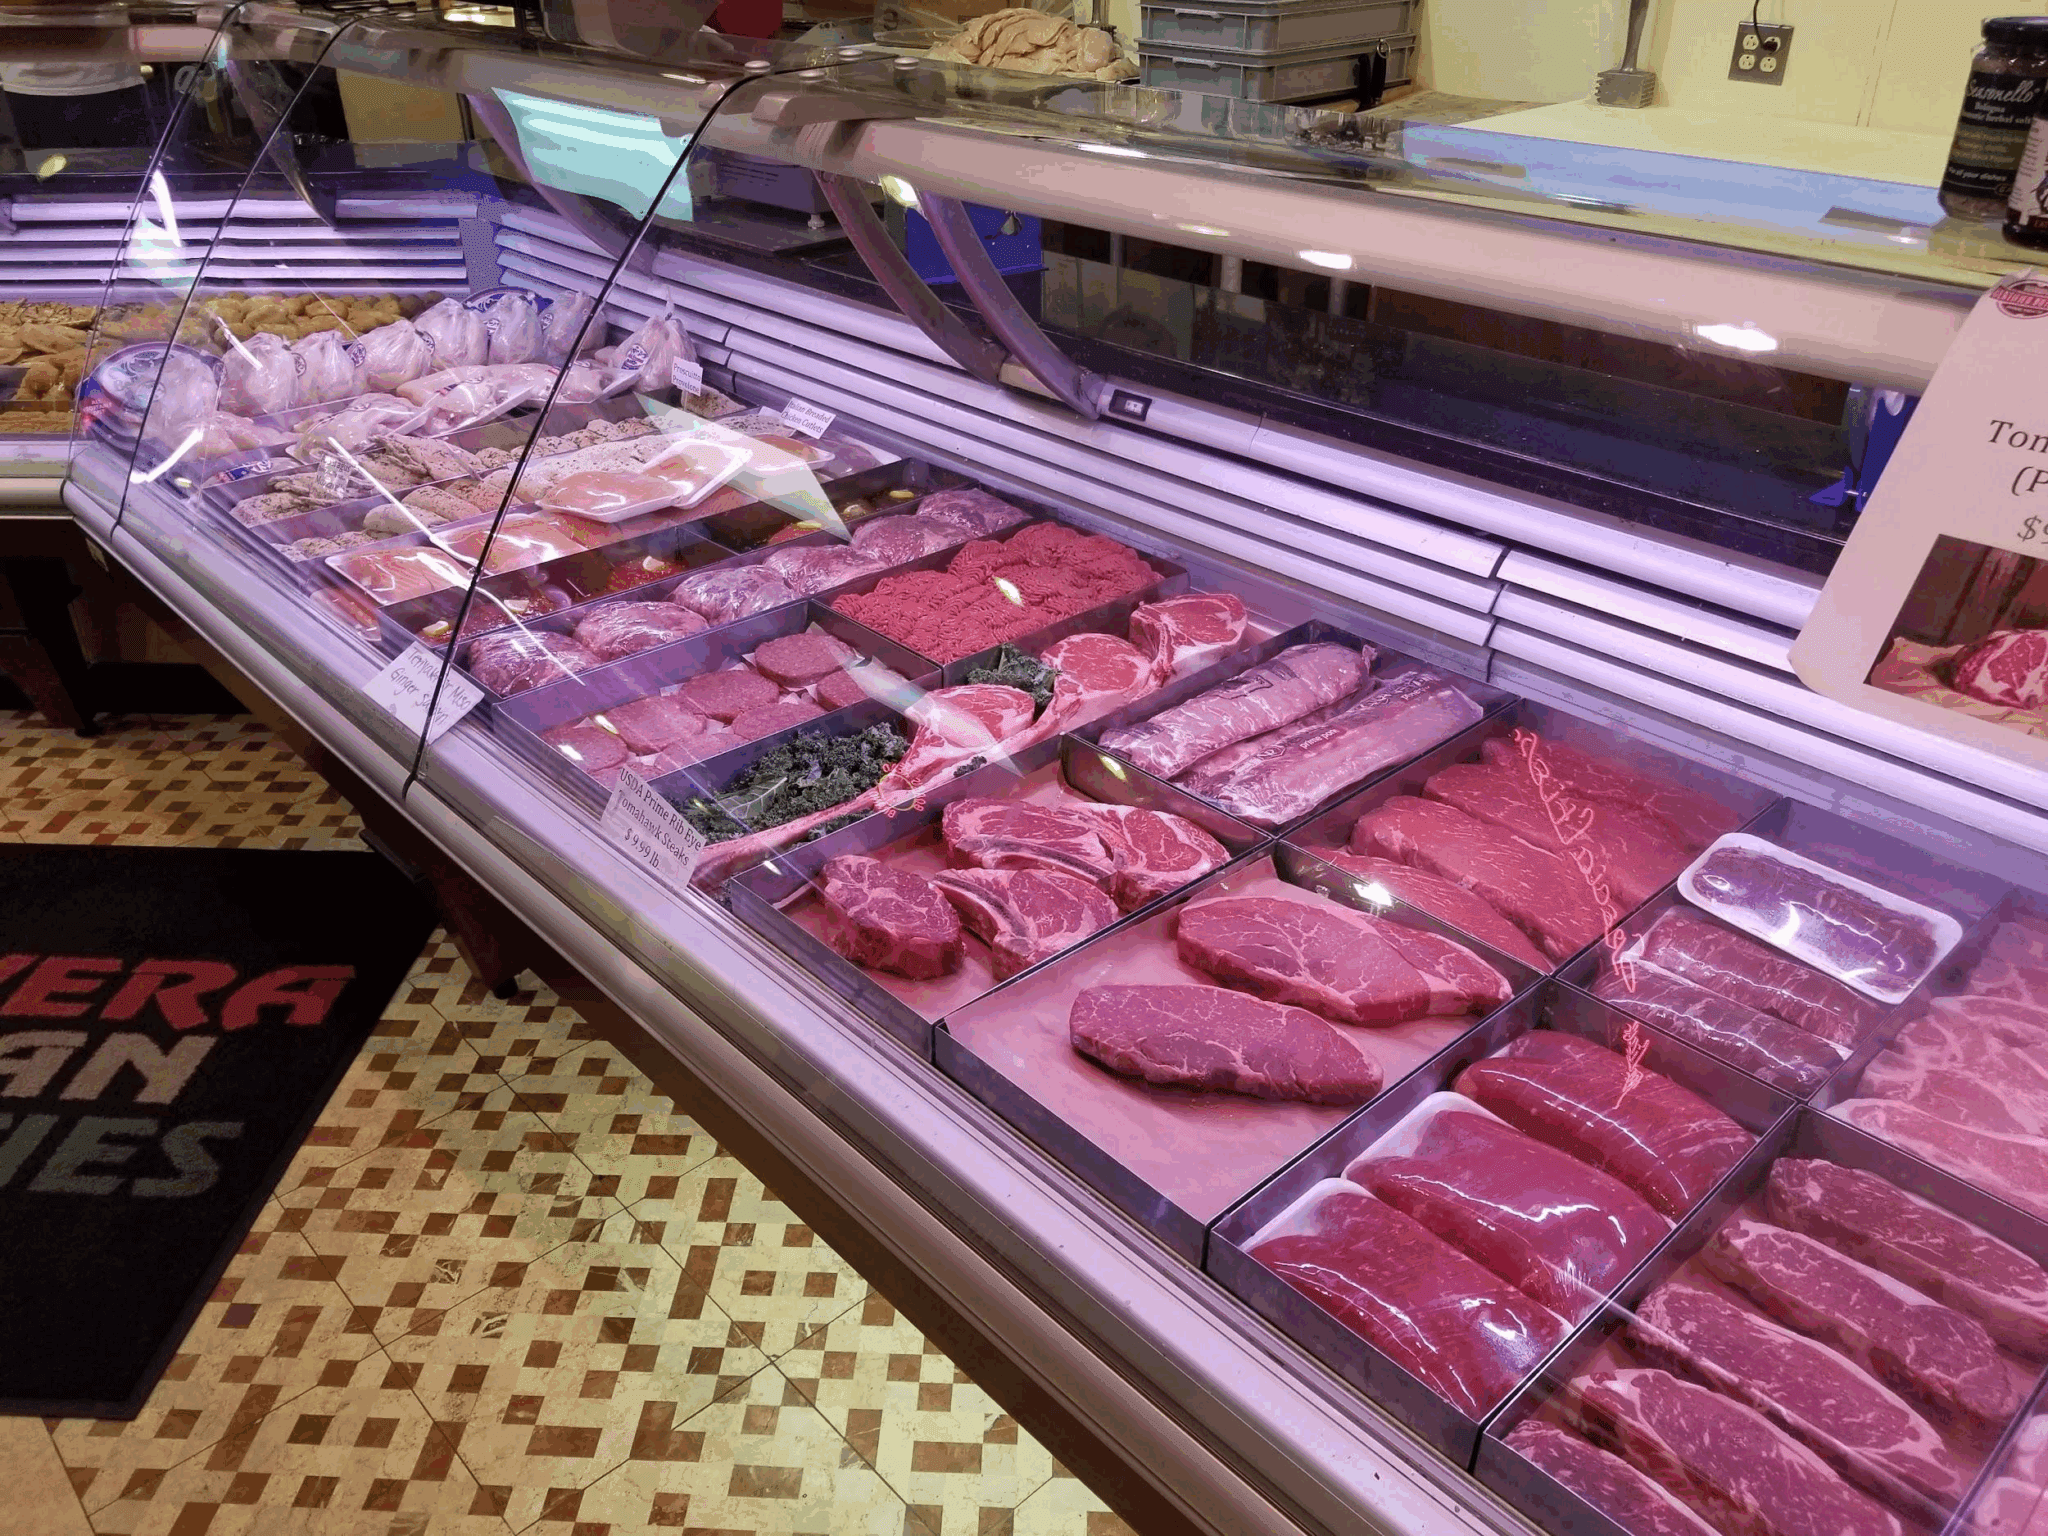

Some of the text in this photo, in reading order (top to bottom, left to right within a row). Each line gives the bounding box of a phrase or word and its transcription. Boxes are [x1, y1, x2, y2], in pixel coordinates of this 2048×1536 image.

[801, 418, 824, 434] Cutlets
[804, 408, 832, 424] Breaded
[390, 667, 420, 696] Ginger
[448, 685, 472, 711] Miso
[620, 767, 702, 852] USDA Prime Rib Eye
[614, 788, 690, 867] Tomahawk Steaks
